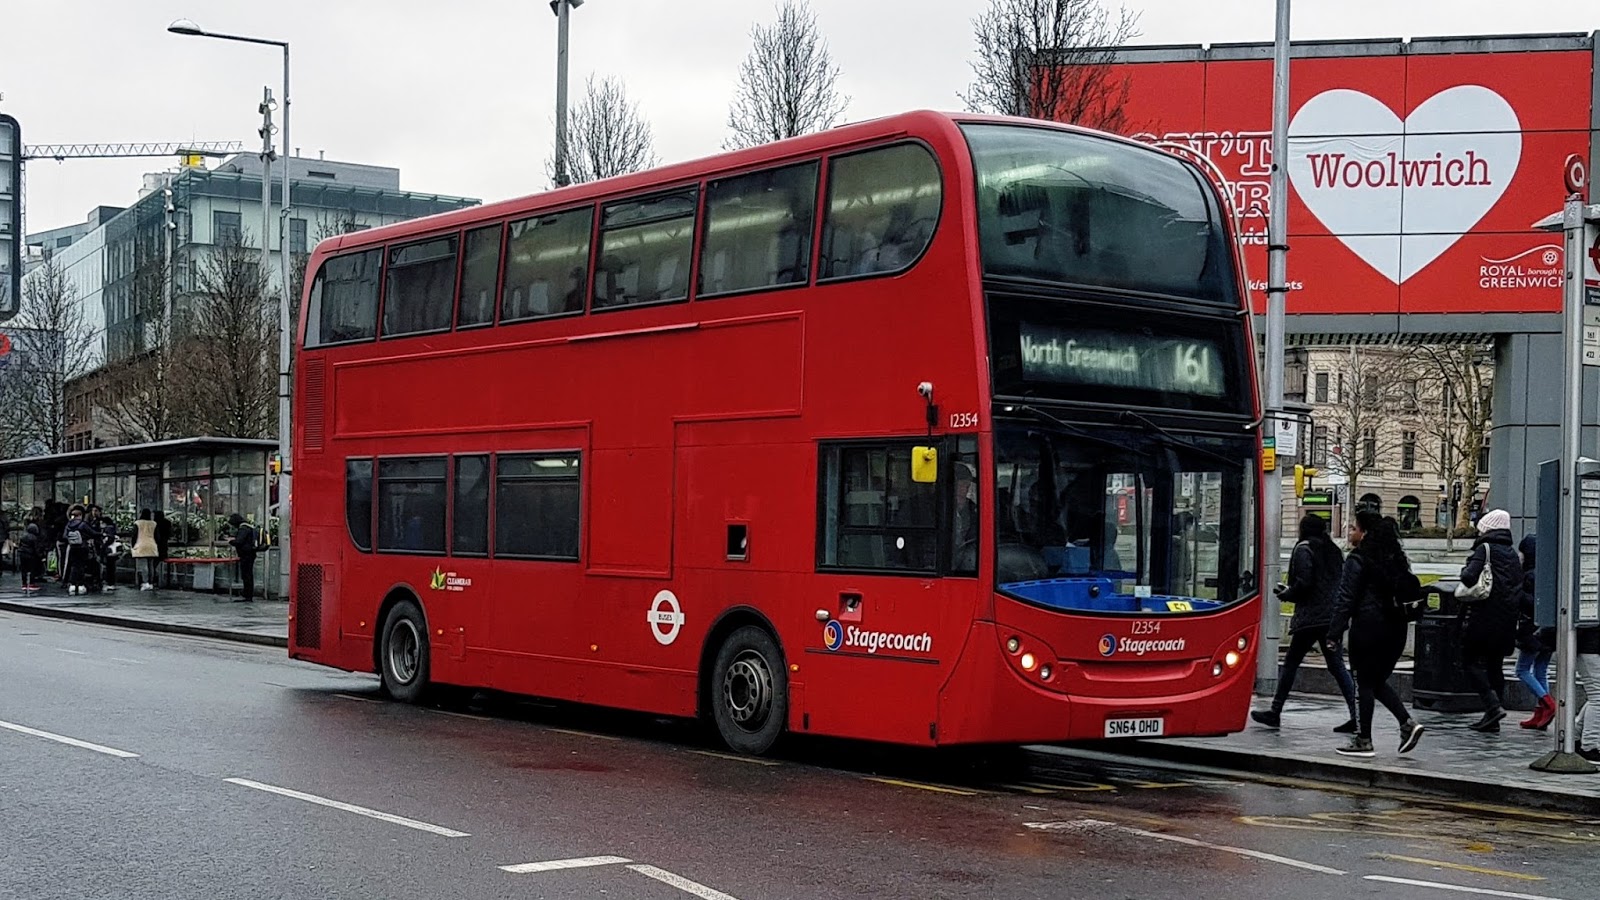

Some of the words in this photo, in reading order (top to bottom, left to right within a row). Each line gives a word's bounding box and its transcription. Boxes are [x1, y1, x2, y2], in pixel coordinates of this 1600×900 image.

[1306, 151, 1491, 188] Woolwich
[1571, 162, 1584, 187] Q
[1480, 265, 1525, 276] ROYAL
[1527, 267, 1557, 276] borough
[1020, 335, 1059, 366] North
[1066, 339, 1138, 372] Greenwich
[1175, 343, 1210, 386] 161
[950, 413, 978, 428] 12354
[1131, 621, 1161, 634] 12354
[845, 625, 932, 653] Stagecoach
[1118, 637, 1185, 656] Stagecoach
[1109, 720, 1136, 734] SN64
[1138, 719, 1159, 733] OHD
